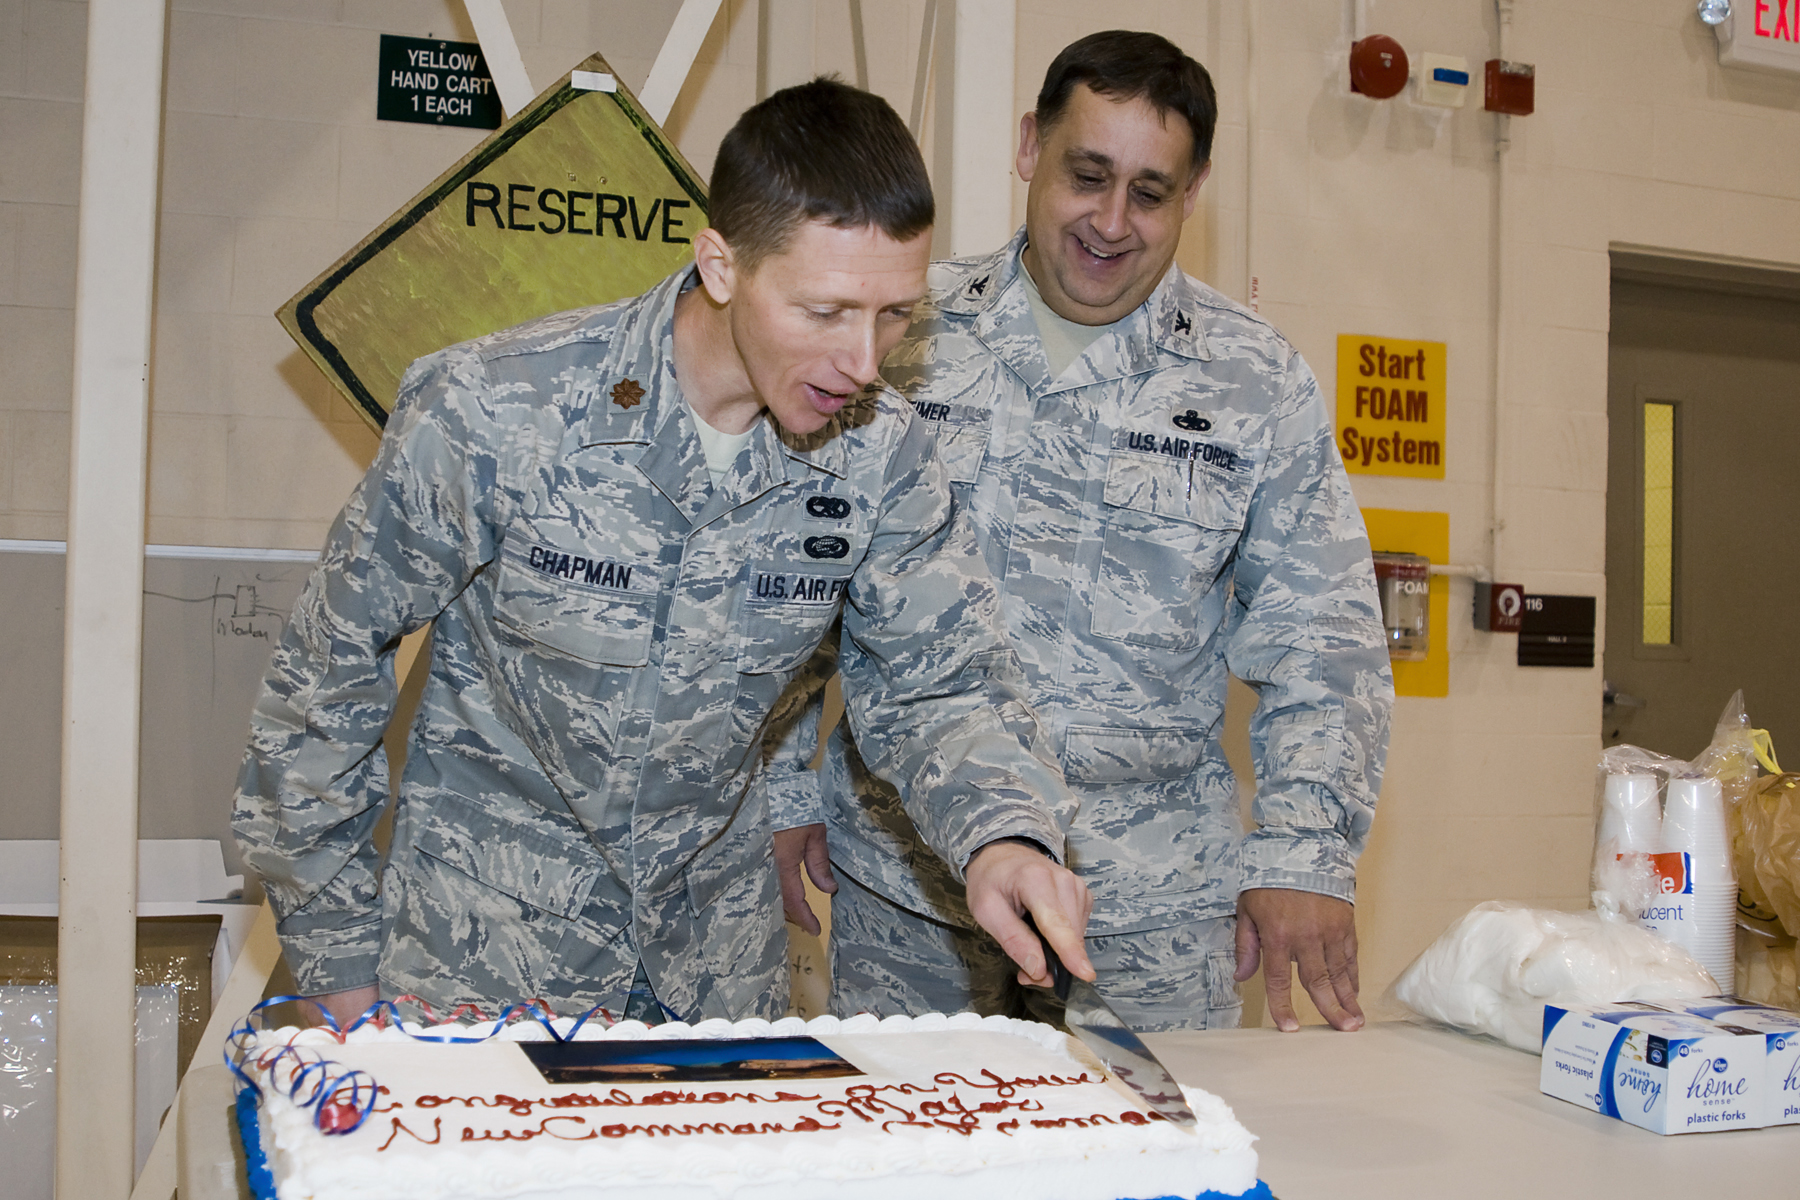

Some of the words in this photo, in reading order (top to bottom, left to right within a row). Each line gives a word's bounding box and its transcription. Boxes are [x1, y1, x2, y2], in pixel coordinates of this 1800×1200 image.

[407, 49, 478, 72] YELLOW
[391, 70, 439, 91] HAND
[446, 74, 492, 95] CART
[411, 94, 419, 112] 1
[425, 95, 472, 116] EACH
[466, 181, 691, 245] RESERVE
[1359, 343, 1426, 381] Start
[1355, 385, 1428, 423] FOAM
[1128, 431, 1158, 453] U.S.
[1161, 436, 1191, 459] AIR
[1193, 441, 1239, 471] FORCE
[1342, 426, 1440, 467] System
[529, 545, 633, 590] CHAPMAN
[756, 574, 789, 599] U.S.
[792, 577, 827, 601] AIR
[1525, 598, 1543, 611] 116
[1498, 617, 1521, 626] FIRE
[1555, 1060, 1572, 1075] forks
[1572, 1066, 1594, 1080] plastic
[1686, 1058, 1749, 1099] home
[1618, 1072, 1661, 1113] home
[1702, 1098, 1732, 1106] sense
[1687, 1112, 1719, 1127] plastic
[1722, 1110, 1746, 1121] forks
